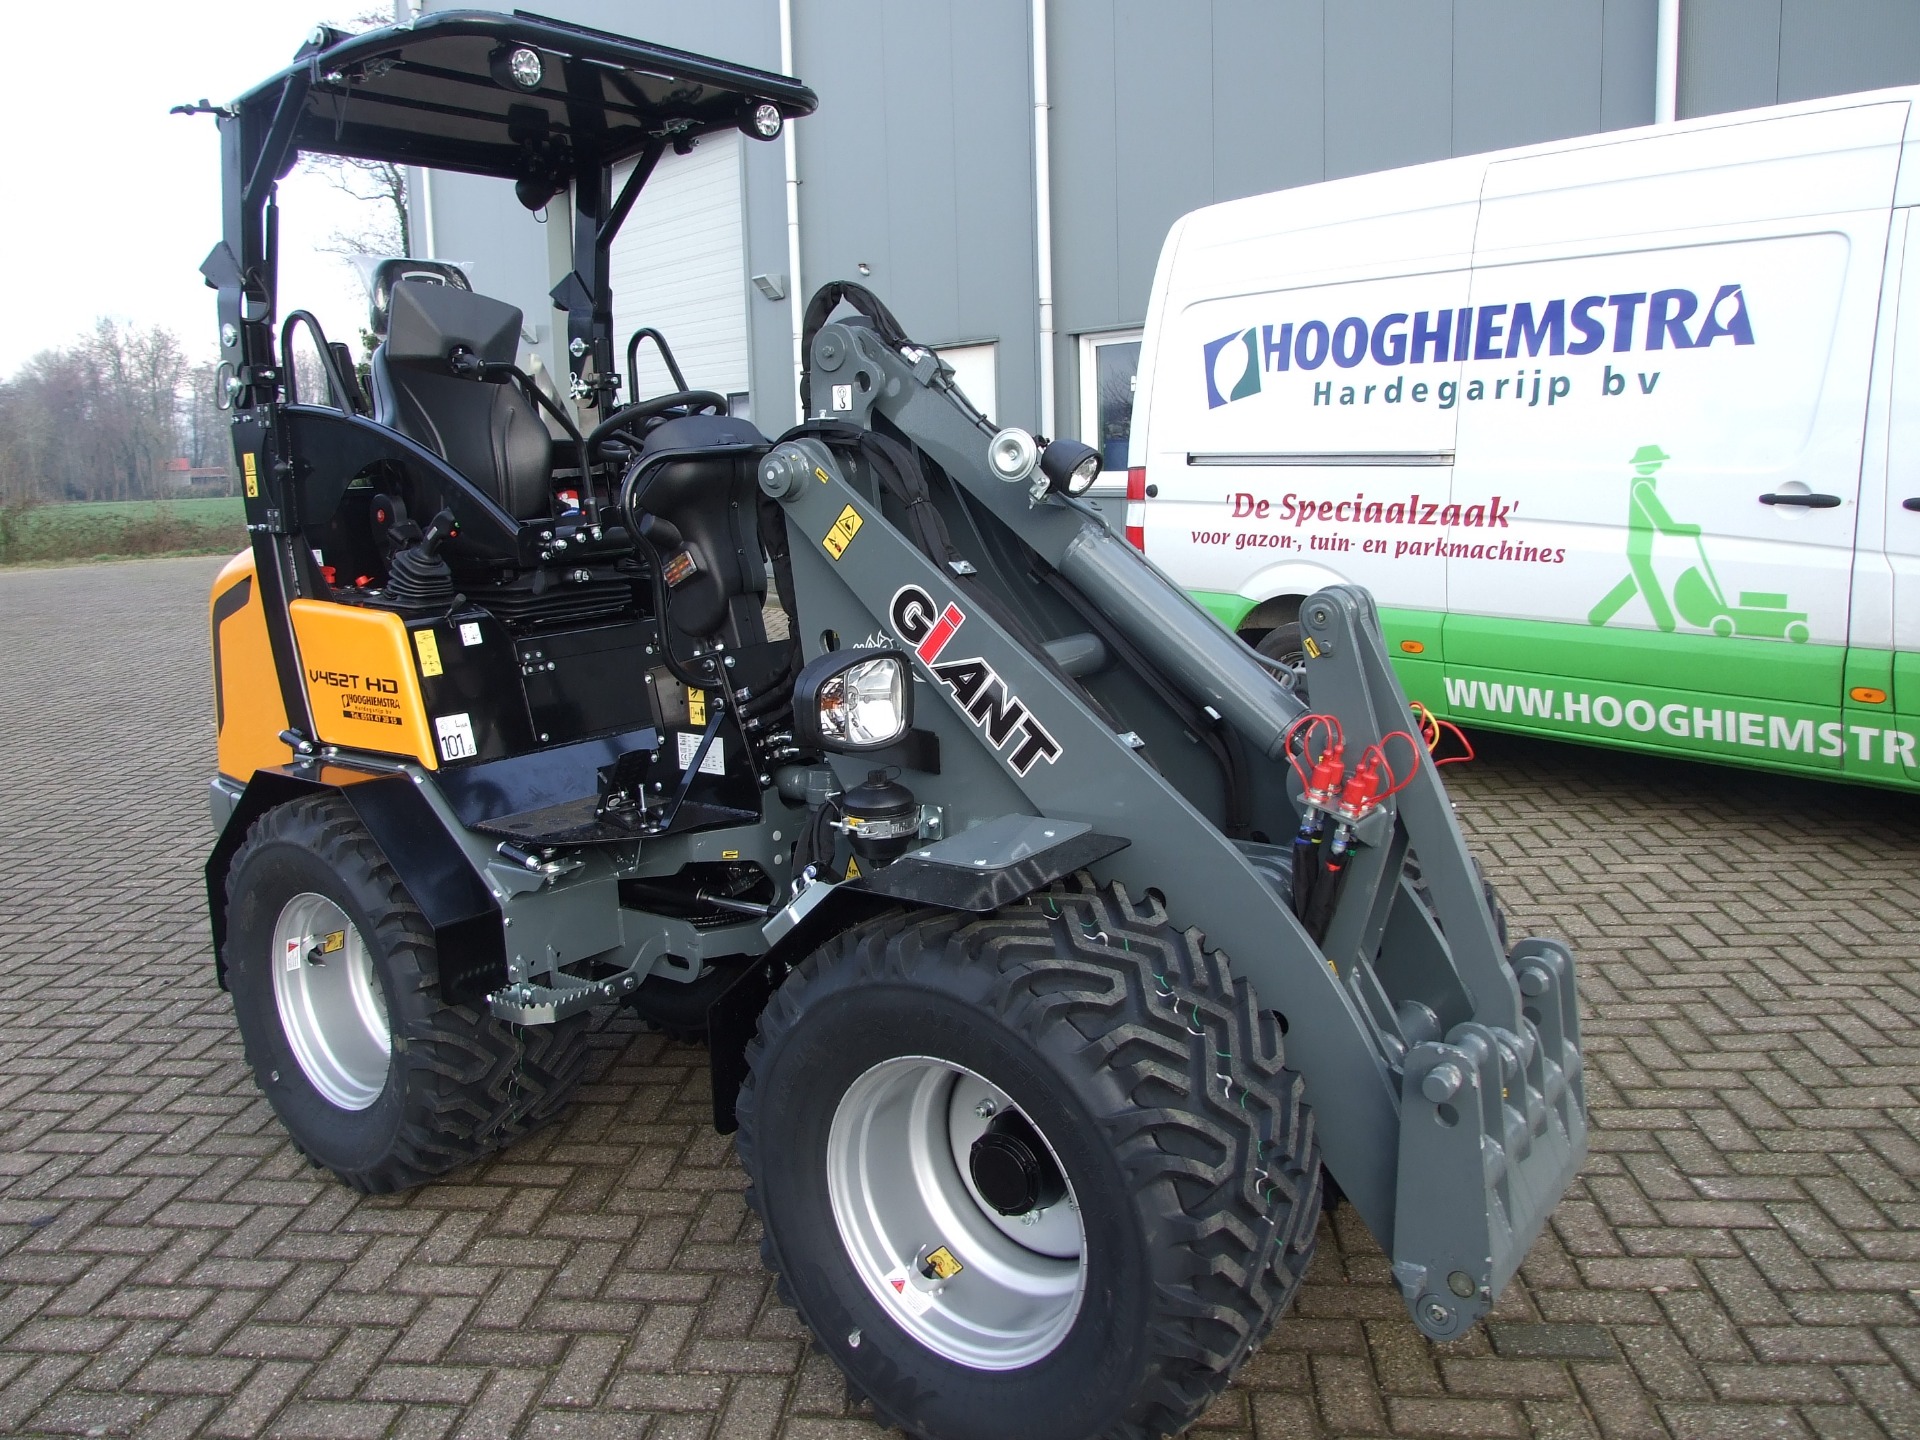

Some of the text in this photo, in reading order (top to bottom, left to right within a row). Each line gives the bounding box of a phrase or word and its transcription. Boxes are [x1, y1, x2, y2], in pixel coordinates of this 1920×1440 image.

[1262, 283, 1755, 372] HOOGHIEMSTRA
[1313, 365, 1661, 409] Hardegarijp bv
[1226, 492, 1519, 528] 'De Speciaalzaak'
[1191, 531, 1566, 564] voor gazon-, tuin- en parkmachines
[309, 669, 398, 694] V452T HD
[348, 694, 401, 709] HOOGHIEMSTRA
[1443, 676, 1920, 768] WWW.HOOGHIEMSTR
[441, 733, 466, 758] 101
